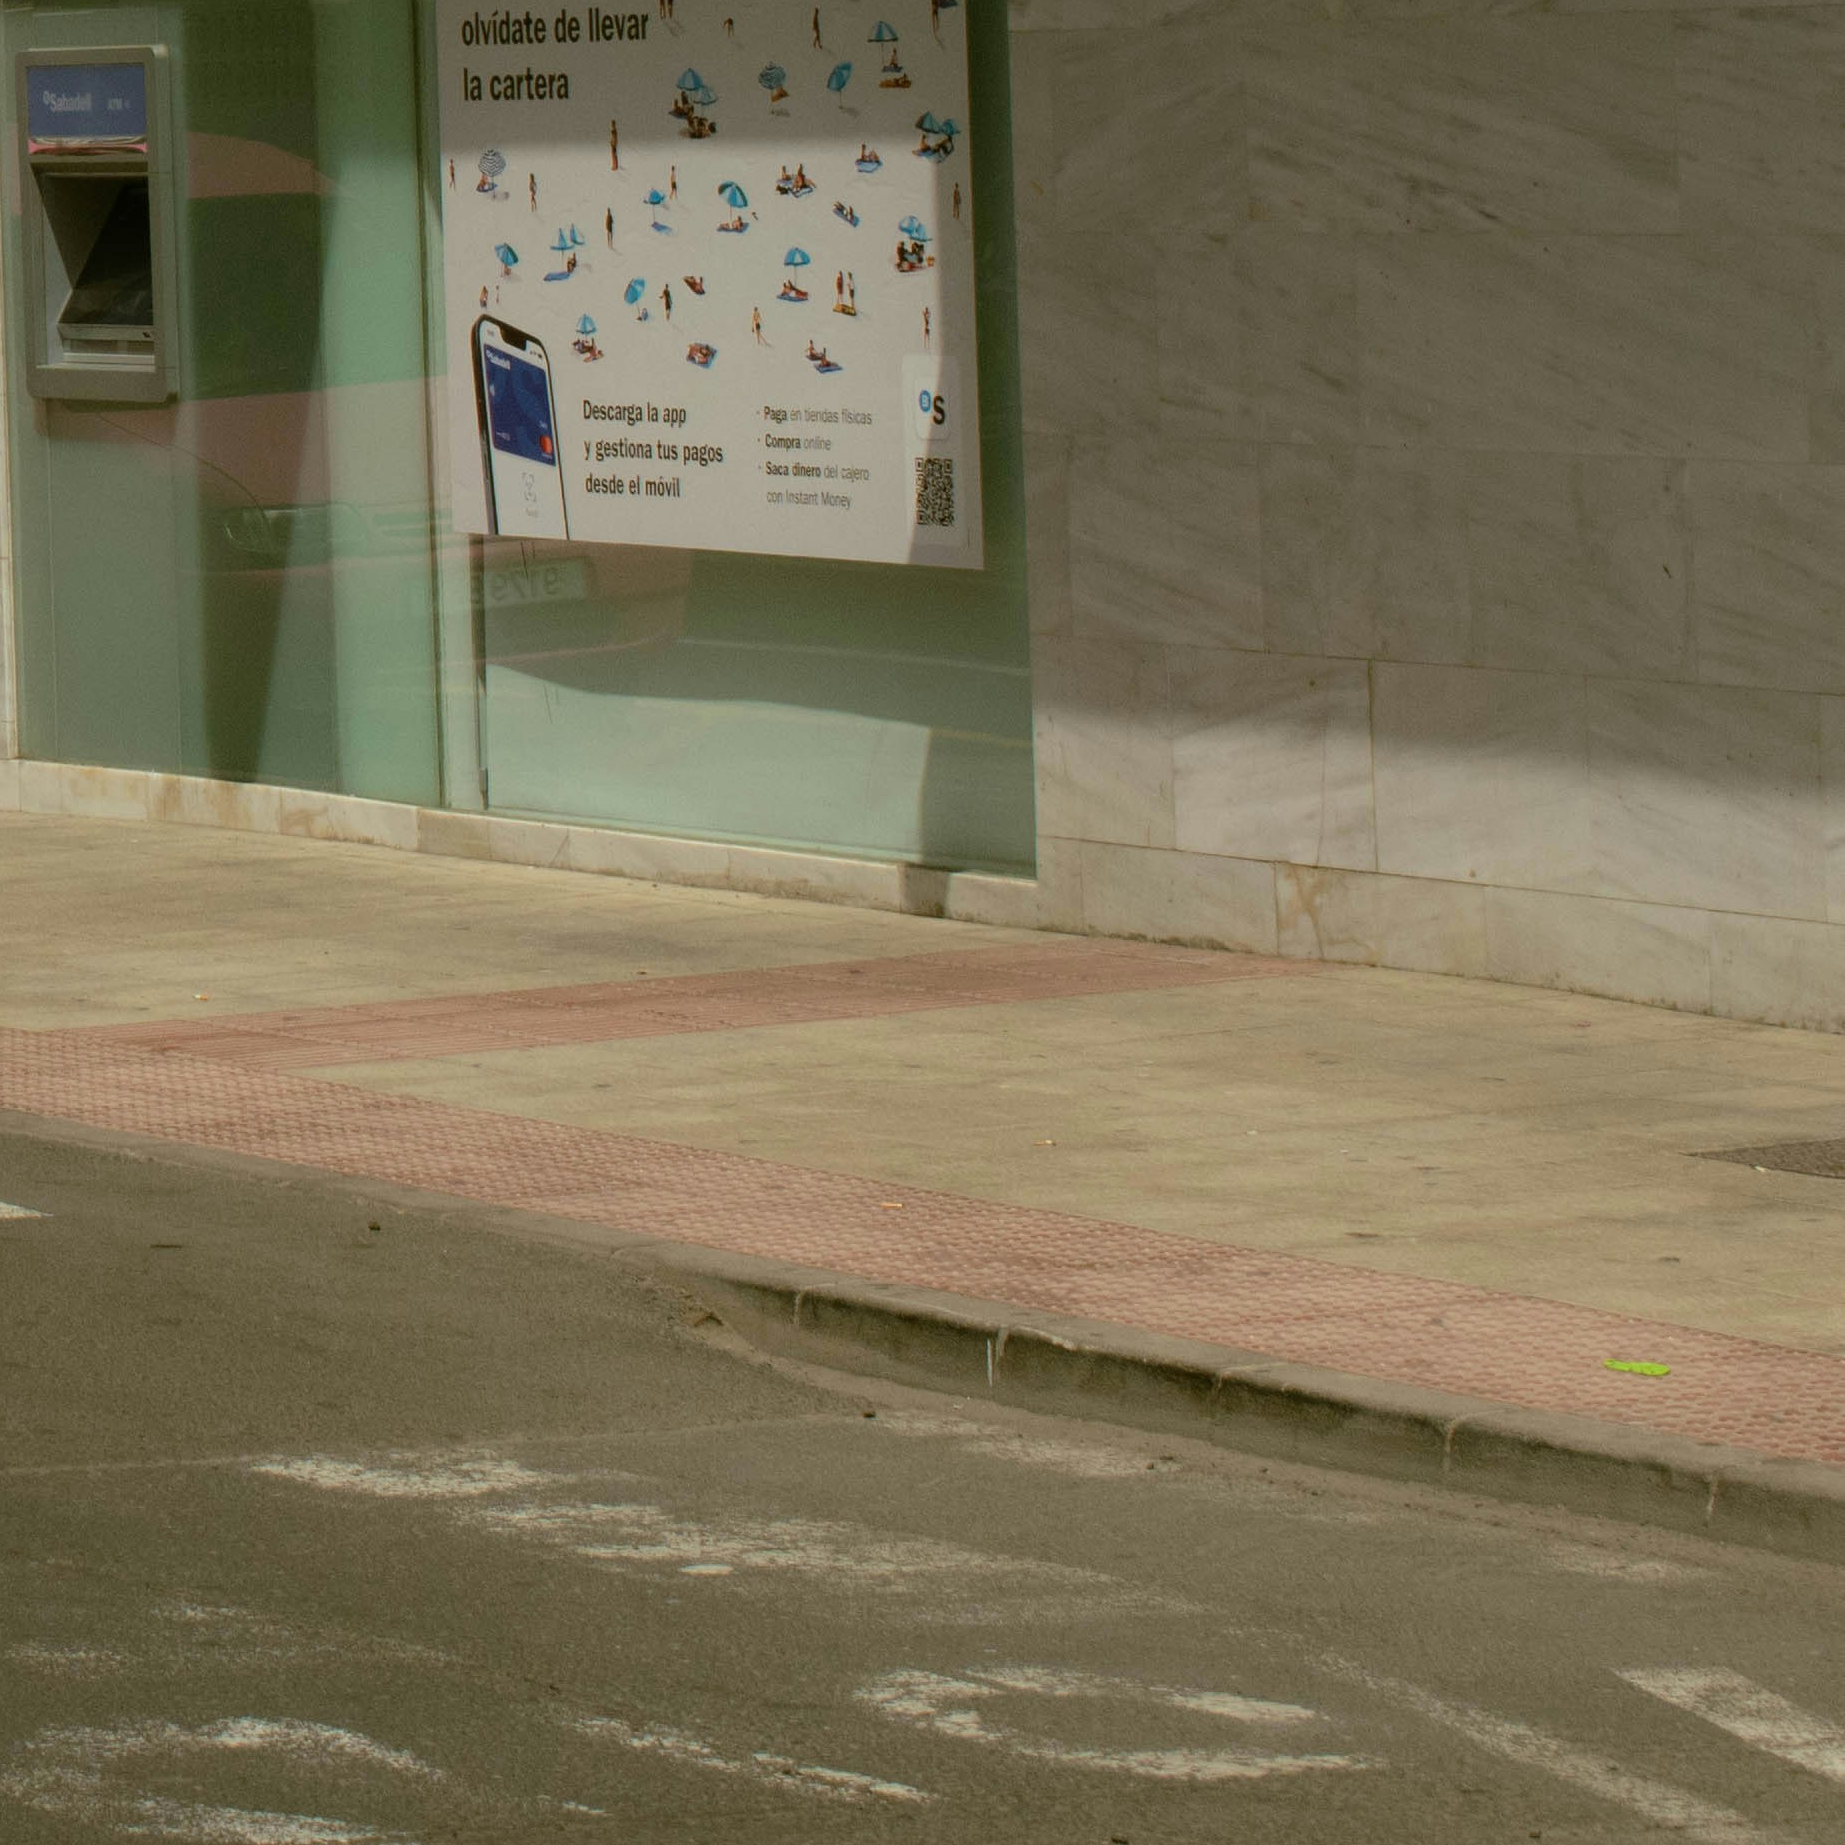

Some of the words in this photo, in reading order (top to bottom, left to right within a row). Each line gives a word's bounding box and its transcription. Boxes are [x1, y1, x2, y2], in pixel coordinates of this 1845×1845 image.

[461, 10, 546, 47] olvídate
[554, 8, 581, 44] de
[588, 6, 649, 43] llevar
[463, 66, 483, 101] la
[489, 67, 570, 101] cartera
[49, 93, 93, 112] Sabadell
[582, 399, 644, 427] Descarga
[647, 401, 659, 422] la
[662, 407, 687, 428] app
[764, 405, 788, 424] Paga
[790, 409, 802, 422] en
[805, 407, 839, 424] tiendas
[583, 440, 592, 461] y
[595, 436, 653, 462] gestiona
[656, 439, 678, 460] tus
[683, 443, 724, 468] pagos
[765, 433, 801, 452] Compra
[803, 436, 832, 451] online
[765, 460, 789, 477] Saca
[792, 461, 822, 479] dinero
[823, 464, 839, 480] del
[841, 465, 870, 484] cajero
[584, 472, 625, 495] desde
[628, 474, 640, 495] el
[645, 475, 682, 498] móvil
[766, 490, 783, 504] con
[786, 489, 819, 506] Instant
[820, 491, 852, 511] Money
